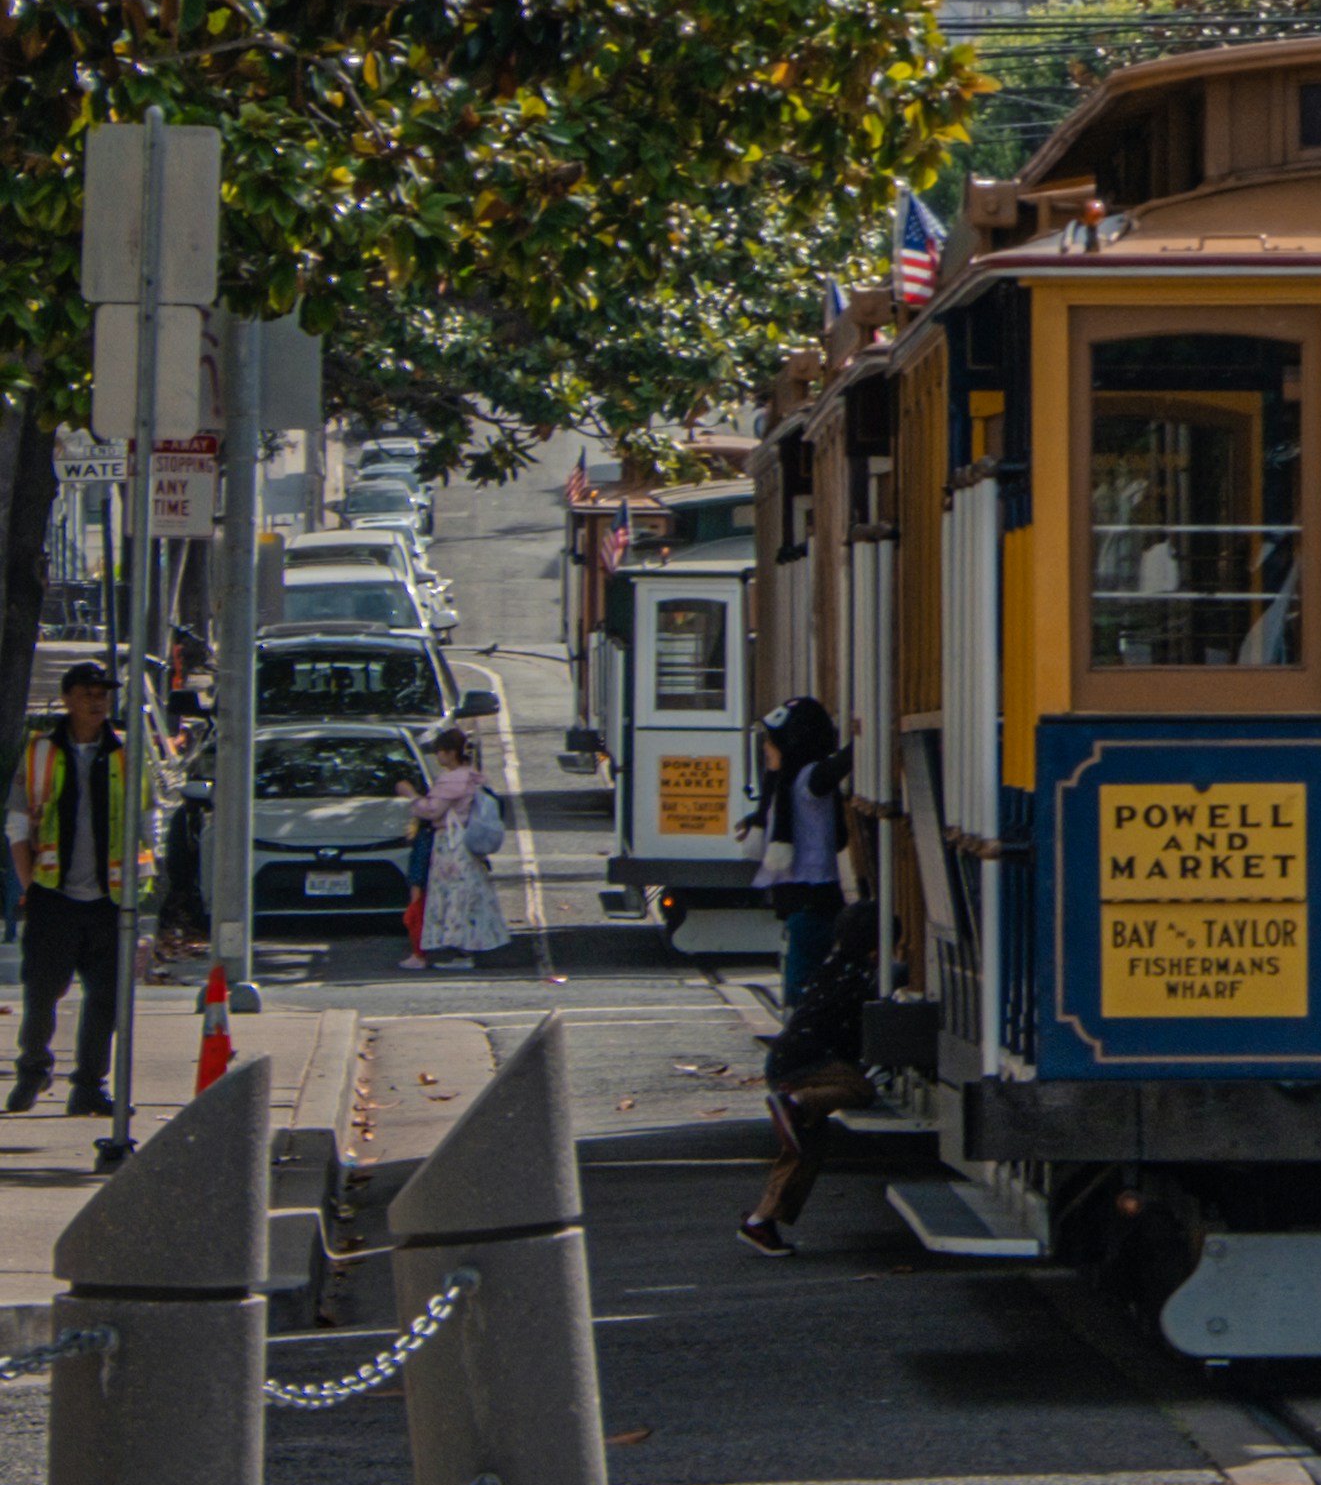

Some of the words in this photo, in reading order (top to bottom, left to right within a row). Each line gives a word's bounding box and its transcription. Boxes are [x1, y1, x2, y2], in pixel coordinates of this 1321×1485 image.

[156, 455, 213, 474] STOPPING
[155, 480, 188, 495] ANY
[153, 499, 190, 517] TIME
[1114, 803, 1294, 830] POWELL
[1161, 832, 1249, 852] AND
[1110, 854, 1297, 880] MARKET
[1112, 918, 1158, 949] BAY
[1202, 918, 1298, 949] TAYLOR
[1127, 956, 1281, 978] FISHERMANS
[1164, 979, 1243, 1000] WHARF
